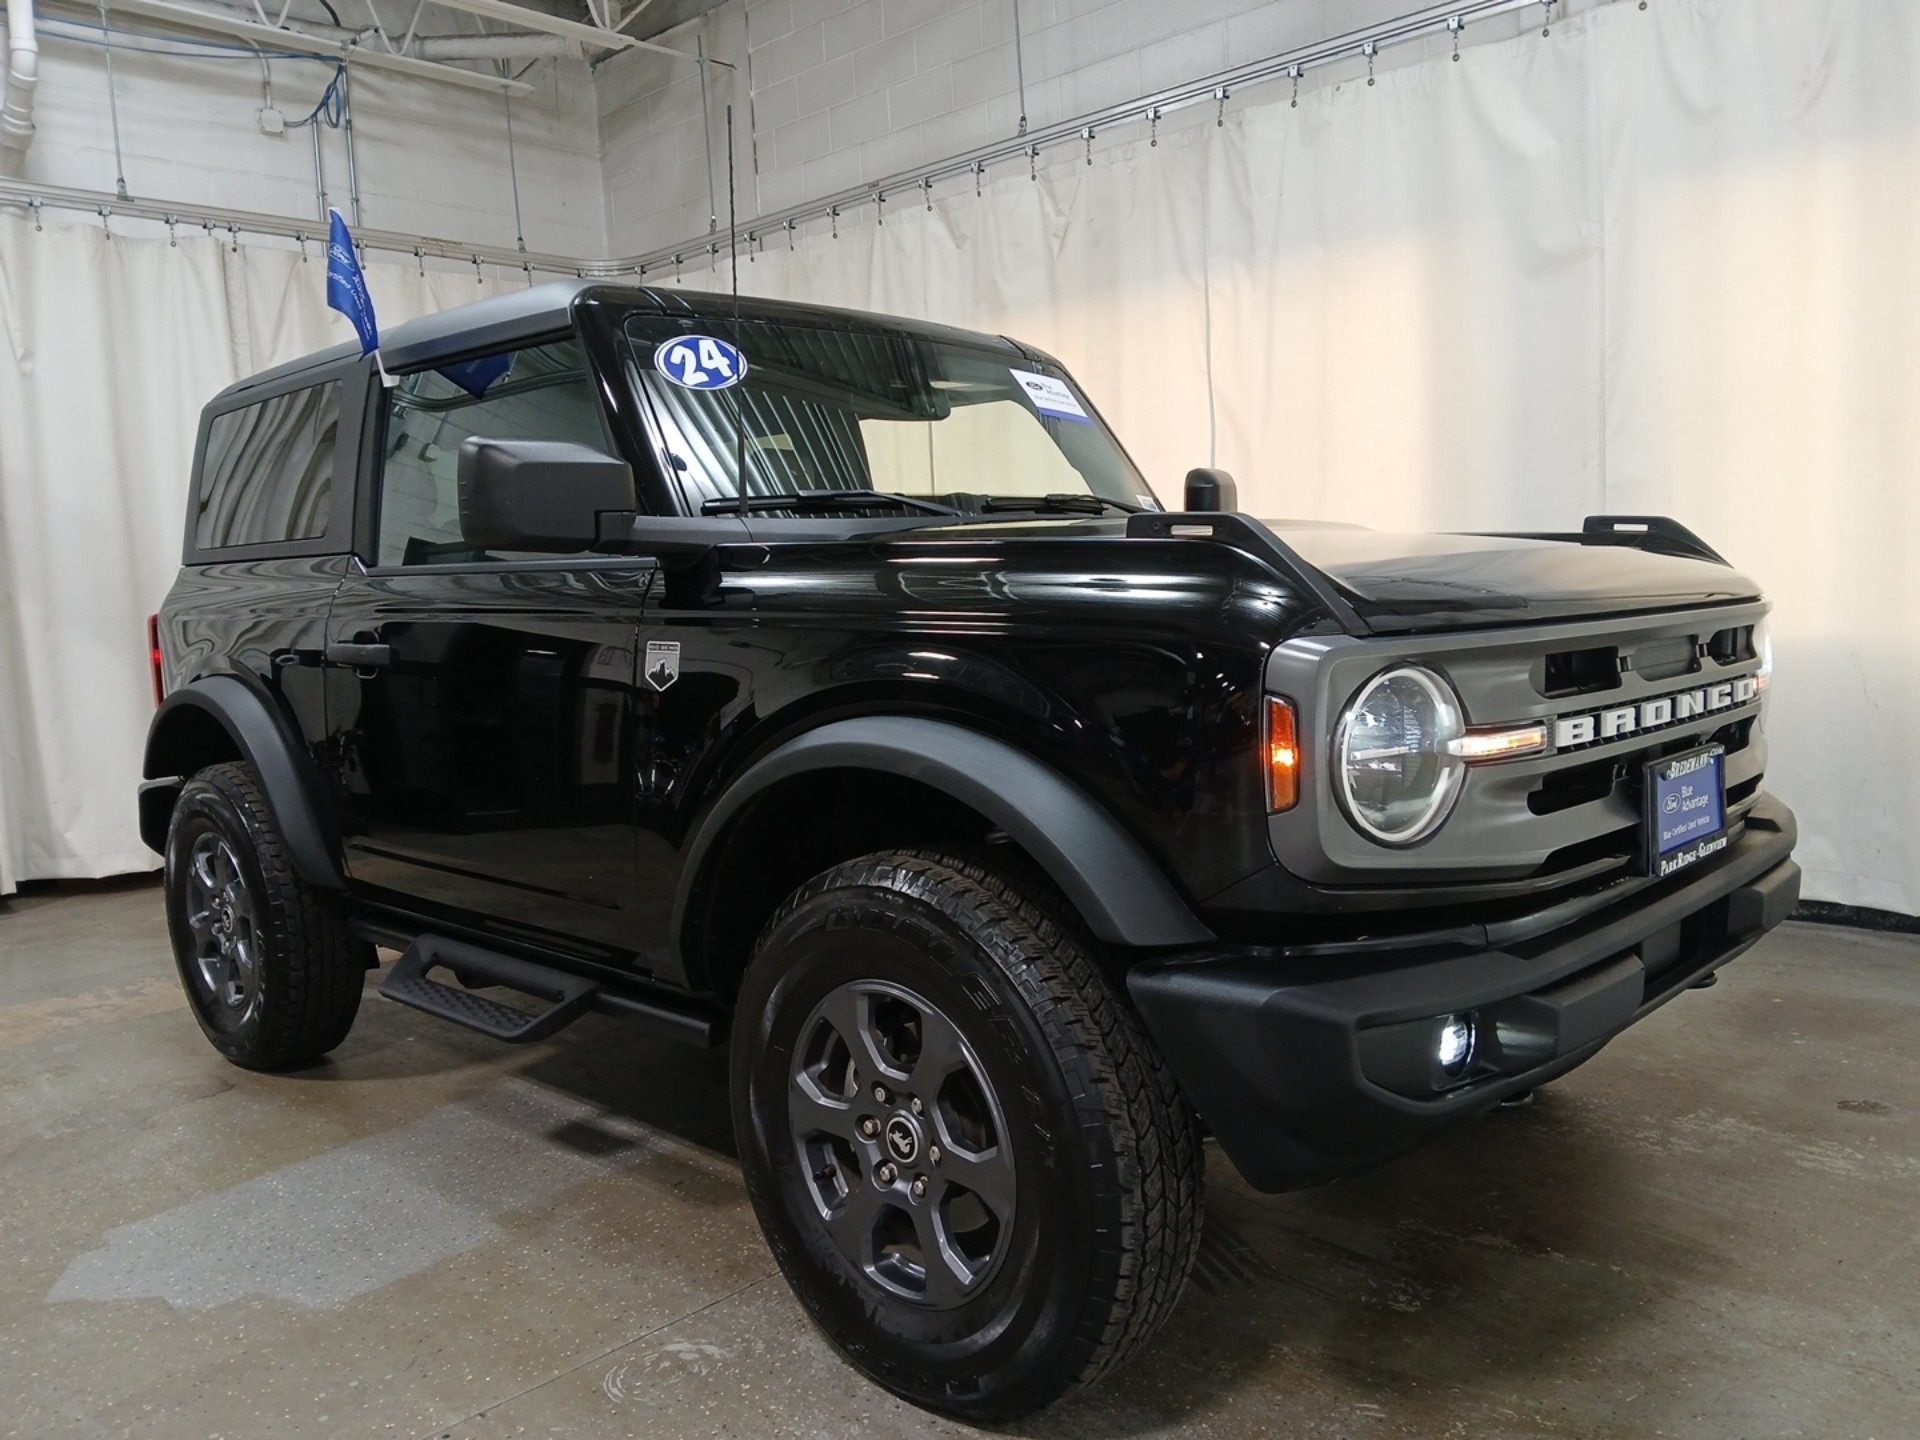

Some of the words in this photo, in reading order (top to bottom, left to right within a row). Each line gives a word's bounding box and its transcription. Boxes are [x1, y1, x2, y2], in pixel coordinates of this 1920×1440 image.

[328, 270, 352, 289] ertified
[670, 339, 733, 386] 24
[1555, 677, 1756, 747] BRONCO
[1681, 785, 1693, 799] Blue
[1665, 795, 1679, 812] Ford
[1682, 794, 1709, 812] Advantage
